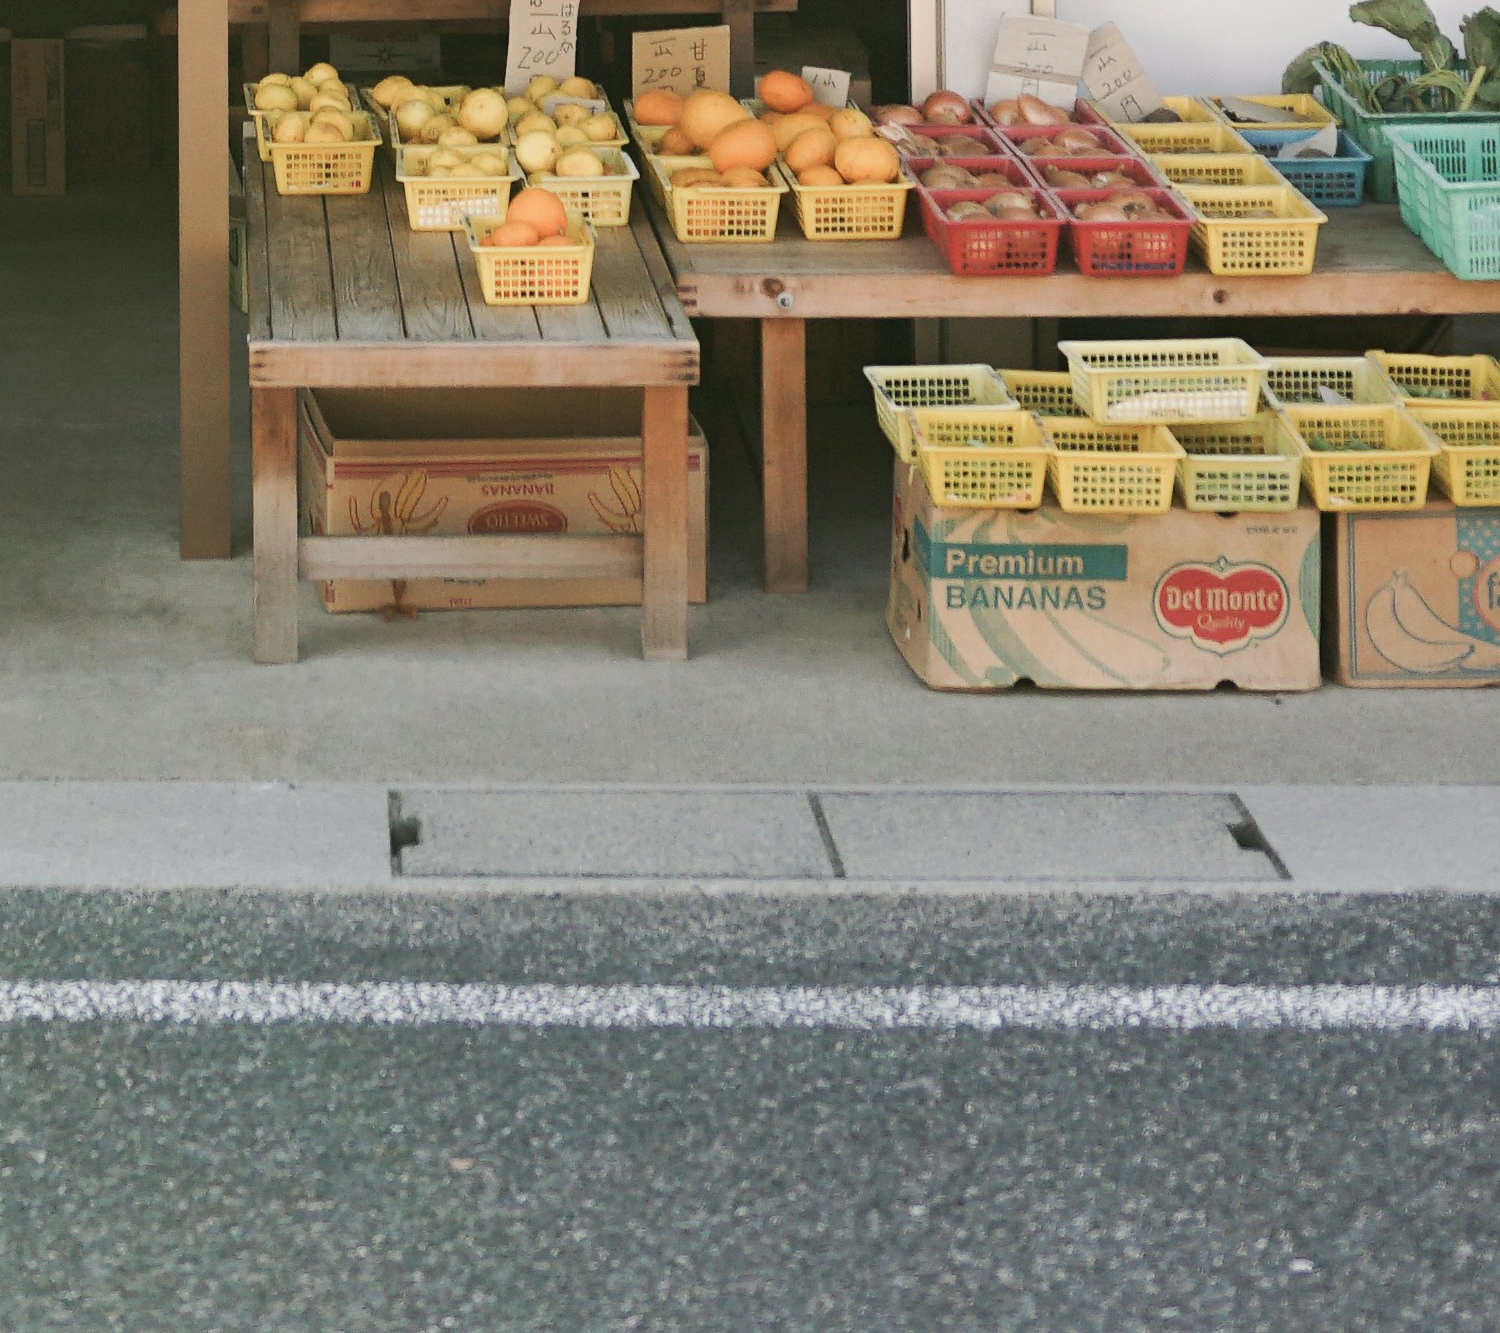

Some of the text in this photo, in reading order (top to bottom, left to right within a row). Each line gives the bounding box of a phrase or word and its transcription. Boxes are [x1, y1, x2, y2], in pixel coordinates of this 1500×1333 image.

[945, 548, 1084, 575] Premium
[945, 585, 1106, 611] BANANAS
[1165, 585, 1280, 612] Del Monte
[1197, 612, 1246, 632] Quality
